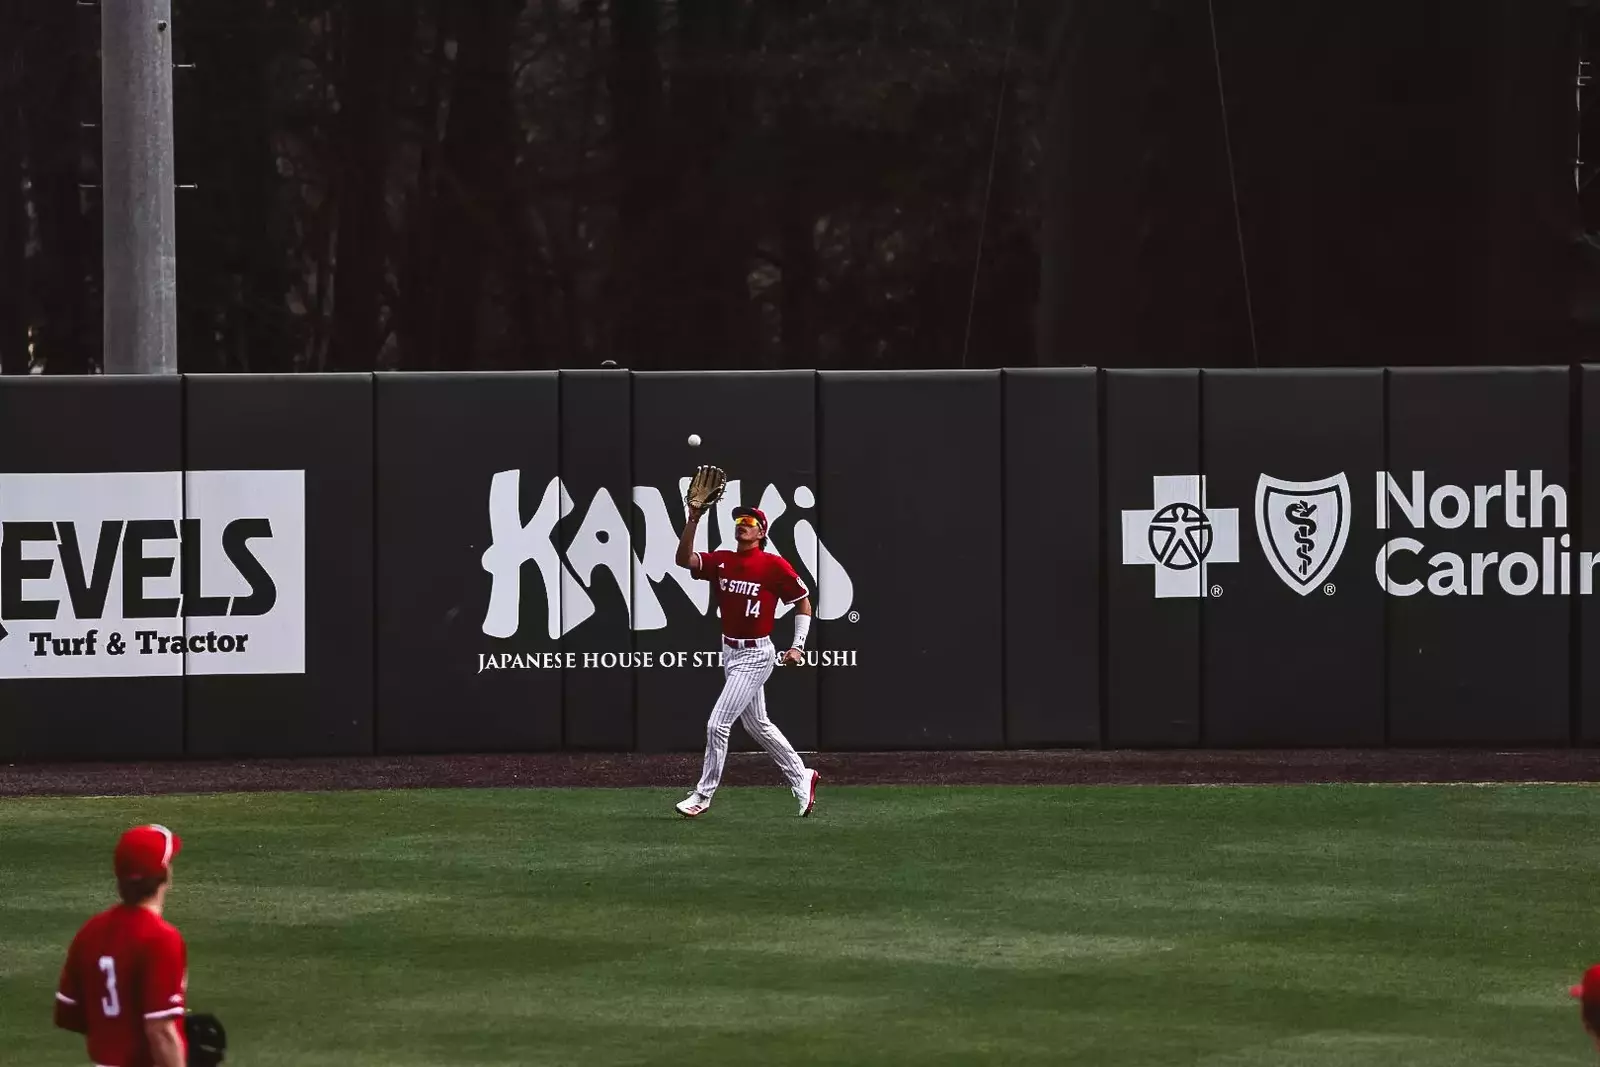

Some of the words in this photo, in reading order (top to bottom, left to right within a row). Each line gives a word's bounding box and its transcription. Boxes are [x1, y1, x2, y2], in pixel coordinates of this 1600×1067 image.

[1376, 469, 1568, 529] North
[0, 518, 277, 621] EVELS
[729, 579, 761, 596] STATE
[745, 599, 761, 618] 14
[29, 629, 99, 657] Turf
[106, 632, 126, 656] &
[135, 629, 249, 655] Tractor
[477, 652, 577, 674] JAPANESE
[583, 651, 654, 668] HOUSE
[659, 651, 688, 668] OF
[796, 650, 858, 667] SUSHI
[98, 955, 121, 1017] 3
